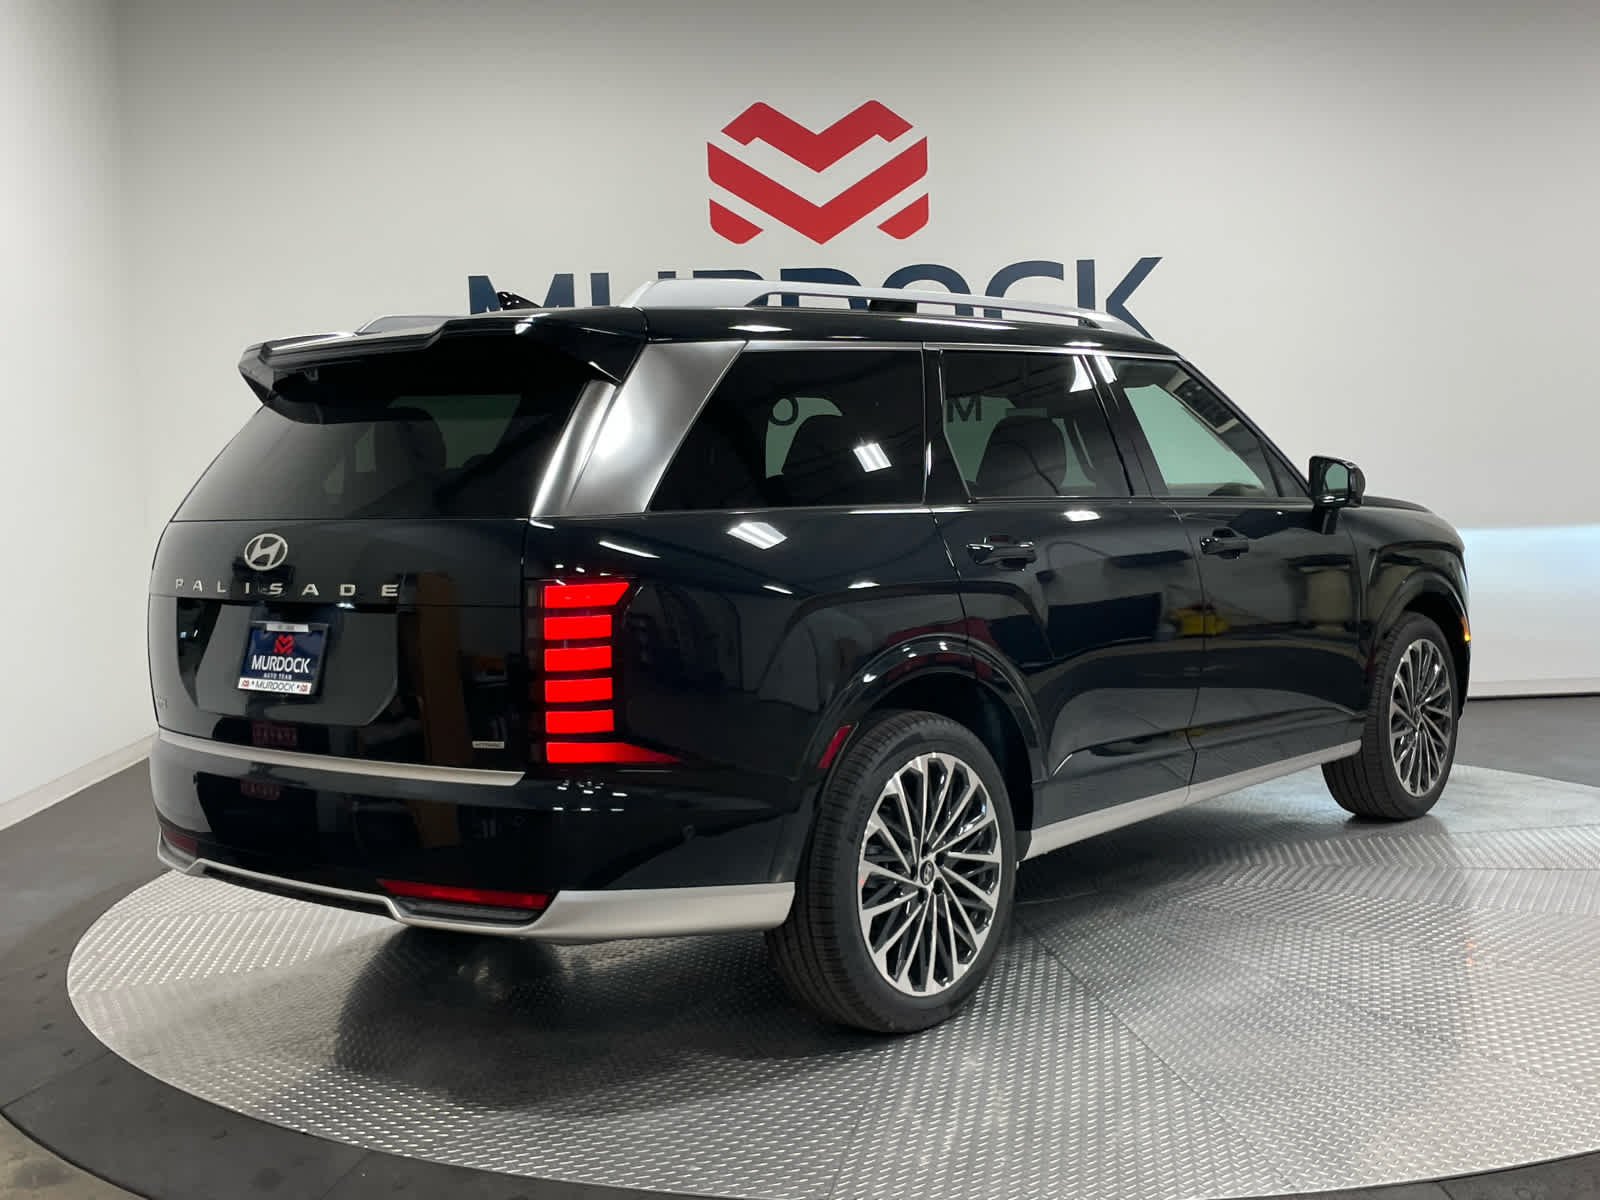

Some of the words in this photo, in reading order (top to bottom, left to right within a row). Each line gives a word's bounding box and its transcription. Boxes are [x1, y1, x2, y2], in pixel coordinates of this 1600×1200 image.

[175, 578, 399, 597] PALISADE
[251, 654, 311, 673] MURDOCK
[255, 681, 295, 691] MURDOCK
